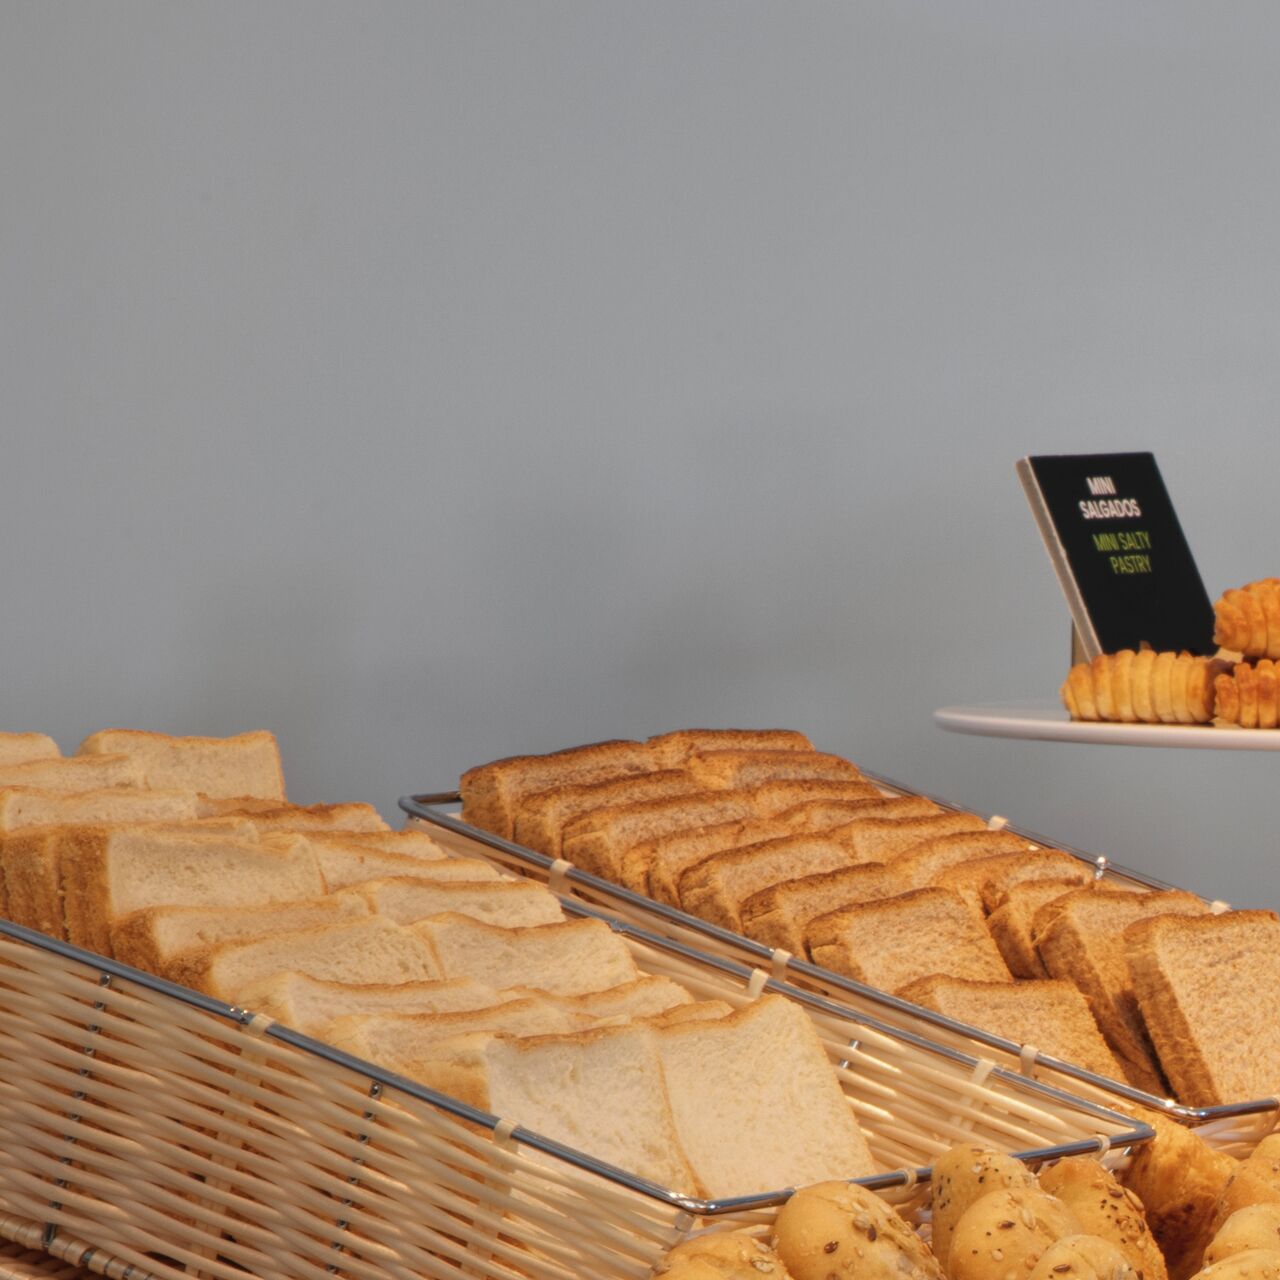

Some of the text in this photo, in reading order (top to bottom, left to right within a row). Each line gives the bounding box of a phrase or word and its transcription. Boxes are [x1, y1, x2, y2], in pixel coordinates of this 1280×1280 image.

[1086, 476, 1117, 496] MINI
[1078, 498, 1142, 519] SALGADOS
[1092, 531, 1152, 551] MINI SALTY
[1109, 554, 1152, 575] PASTRY
